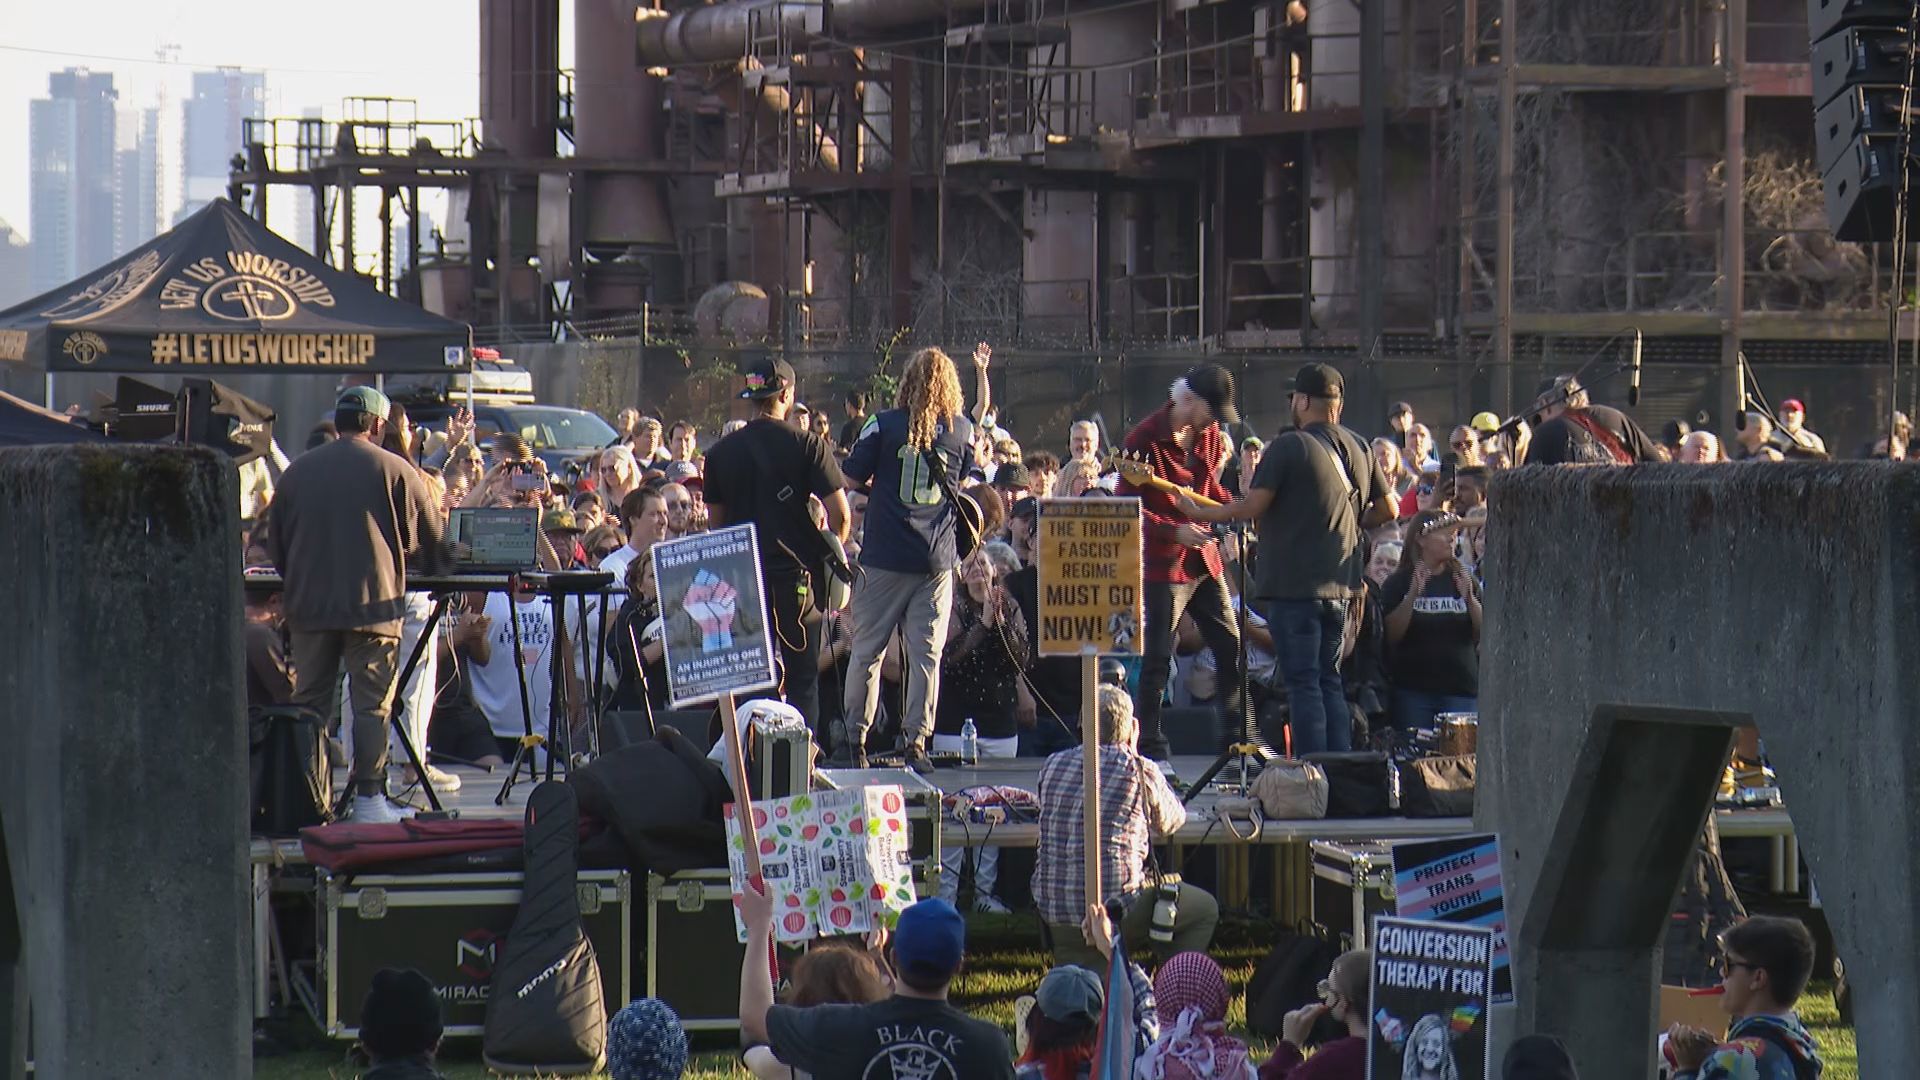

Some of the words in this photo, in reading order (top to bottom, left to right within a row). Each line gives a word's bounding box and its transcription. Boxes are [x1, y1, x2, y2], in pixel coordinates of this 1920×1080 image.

[159, 278, 201, 310] LET
[182, 256, 226, 284] US
[227, 250, 336, 308] WORSHIP
[135, 403, 172, 412] SHURE
[1048, 520, 1076, 538] THE
[1081, 520, 1131, 538] TRUMP
[660, 550, 699, 569] TRANS
[701, 540, 749, 561] RIGHTS!
[1057, 541, 1122, 560] FASCIST
[1061, 562, 1118, 580] REGIME
[1046, 584, 1101, 607] MUST
[1108, 584, 1135, 607] GO
[503, 622, 549, 634] LVES
[1043, 615, 1103, 642] NOW!
[677, 661, 691, 674] AN
[692, 655, 726, 670] INJURY
[727, 651, 740, 662] TO
[741, 647, 761, 660] ONE
[677, 675, 687, 685] IS
[687, 672, 701, 682] AN
[701, 665, 733, 680] INJURY
[735, 663, 747, 673] TO
[747, 659, 765, 670] ALL
[1413, 851, 1477, 883] PROTECT
[1426, 873, 1476, 898] TRANS
[1429, 891, 1482, 916] YOUTH!
[1378, 926, 1488, 965] CONVERSION
[1377, 959, 1449, 993] THERAPY
[1451, 969, 1486, 997] FOR
[432, 985, 491, 999] MIRAC
[875, 1024, 964, 1056] BLACK
